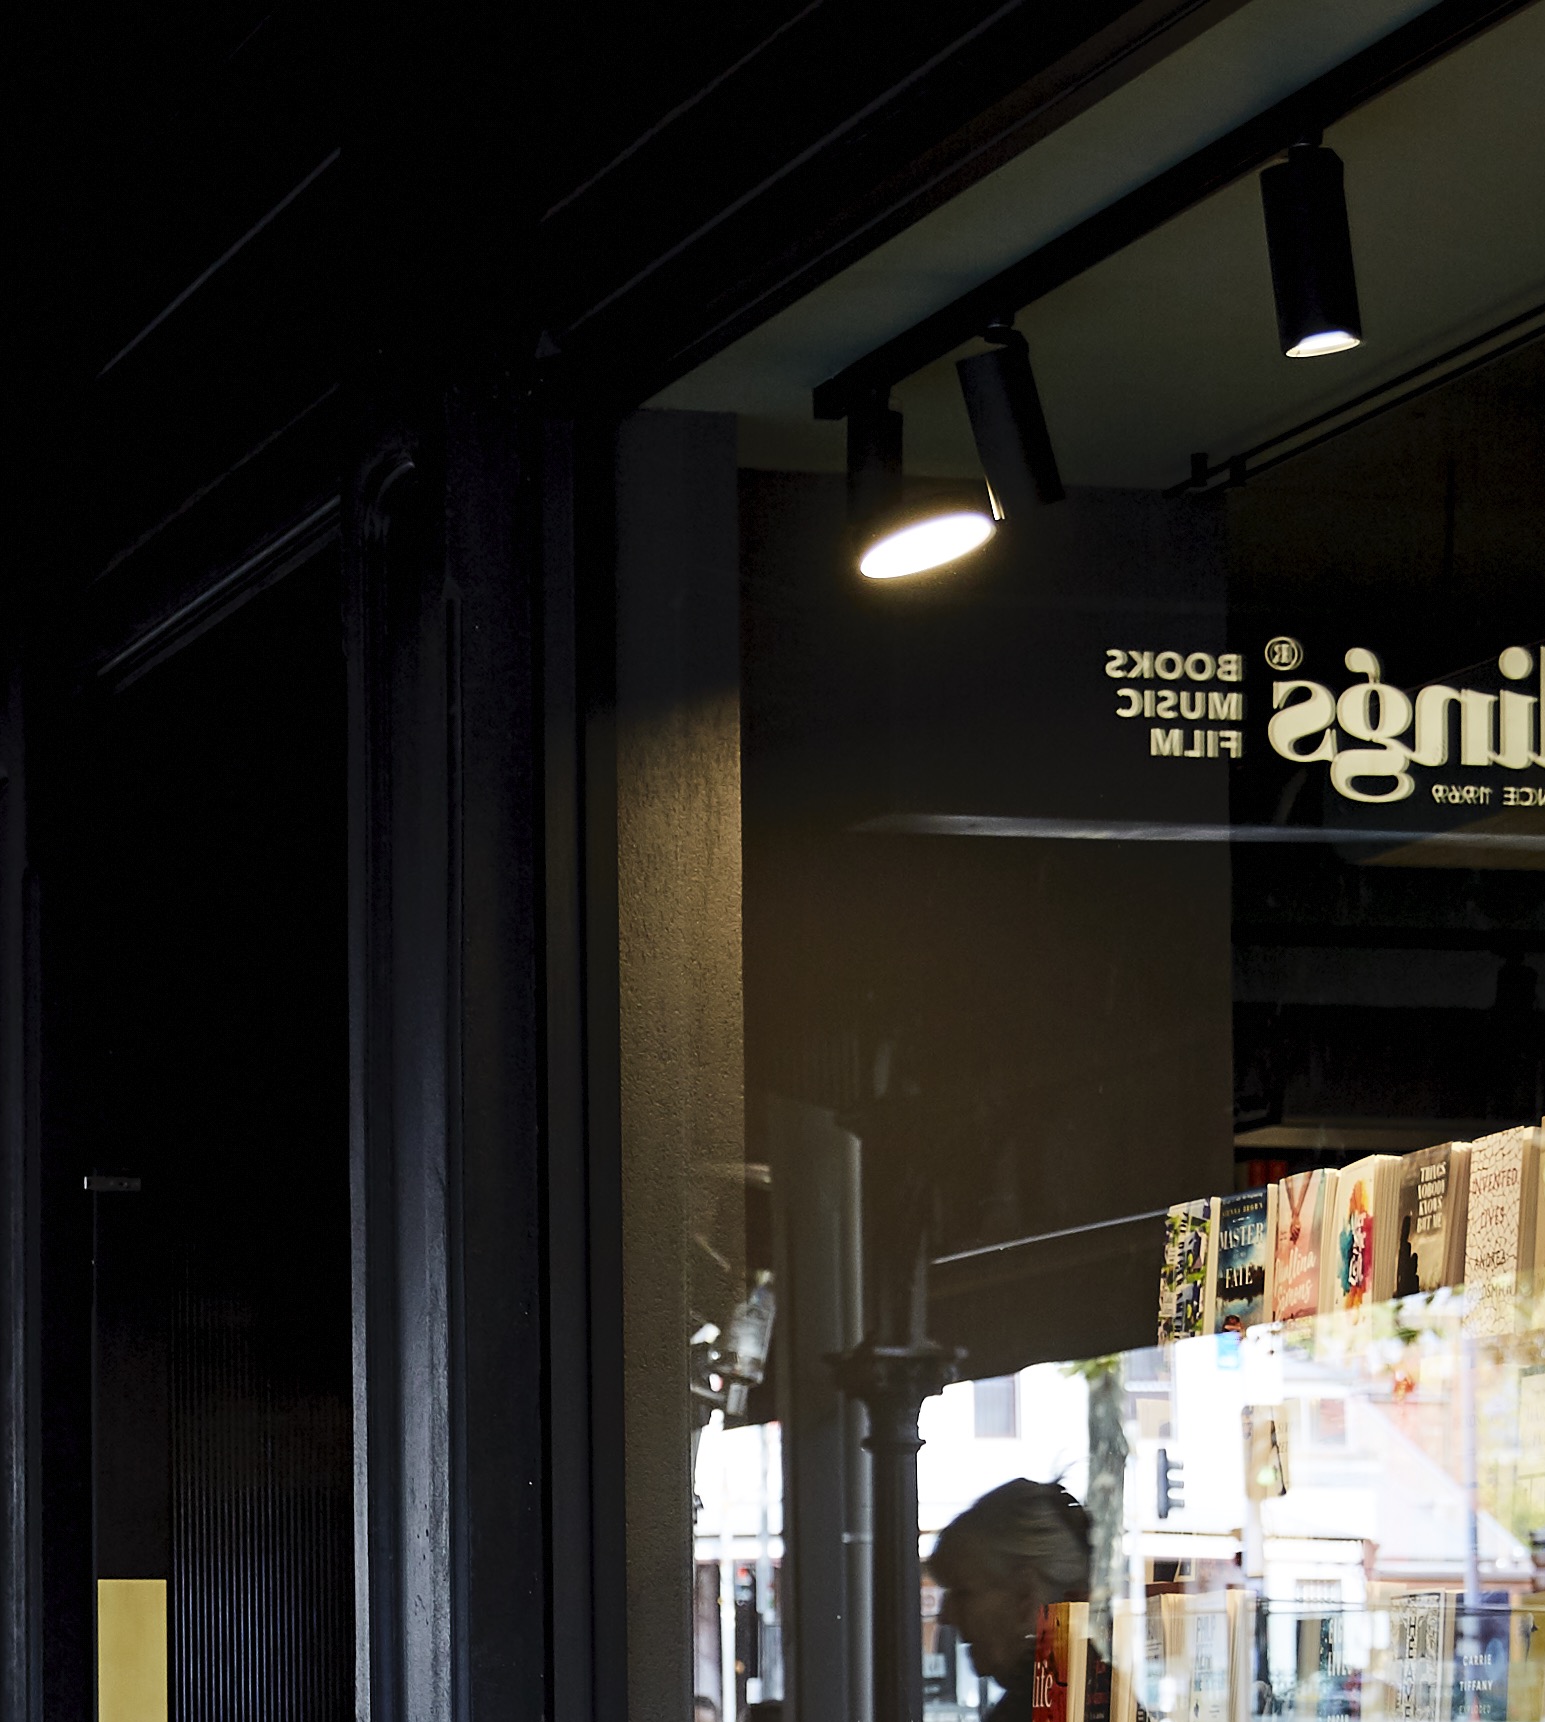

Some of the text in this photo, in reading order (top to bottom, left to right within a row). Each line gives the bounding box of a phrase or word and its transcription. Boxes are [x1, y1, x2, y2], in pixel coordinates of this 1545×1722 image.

[1220, 1222, 1265, 1251] MASTER
[1225, 1266, 1253, 1289] FATE
[1032, 1659, 1054, 1709] life
[1459, 1680, 1493, 1692] TIFFANY
